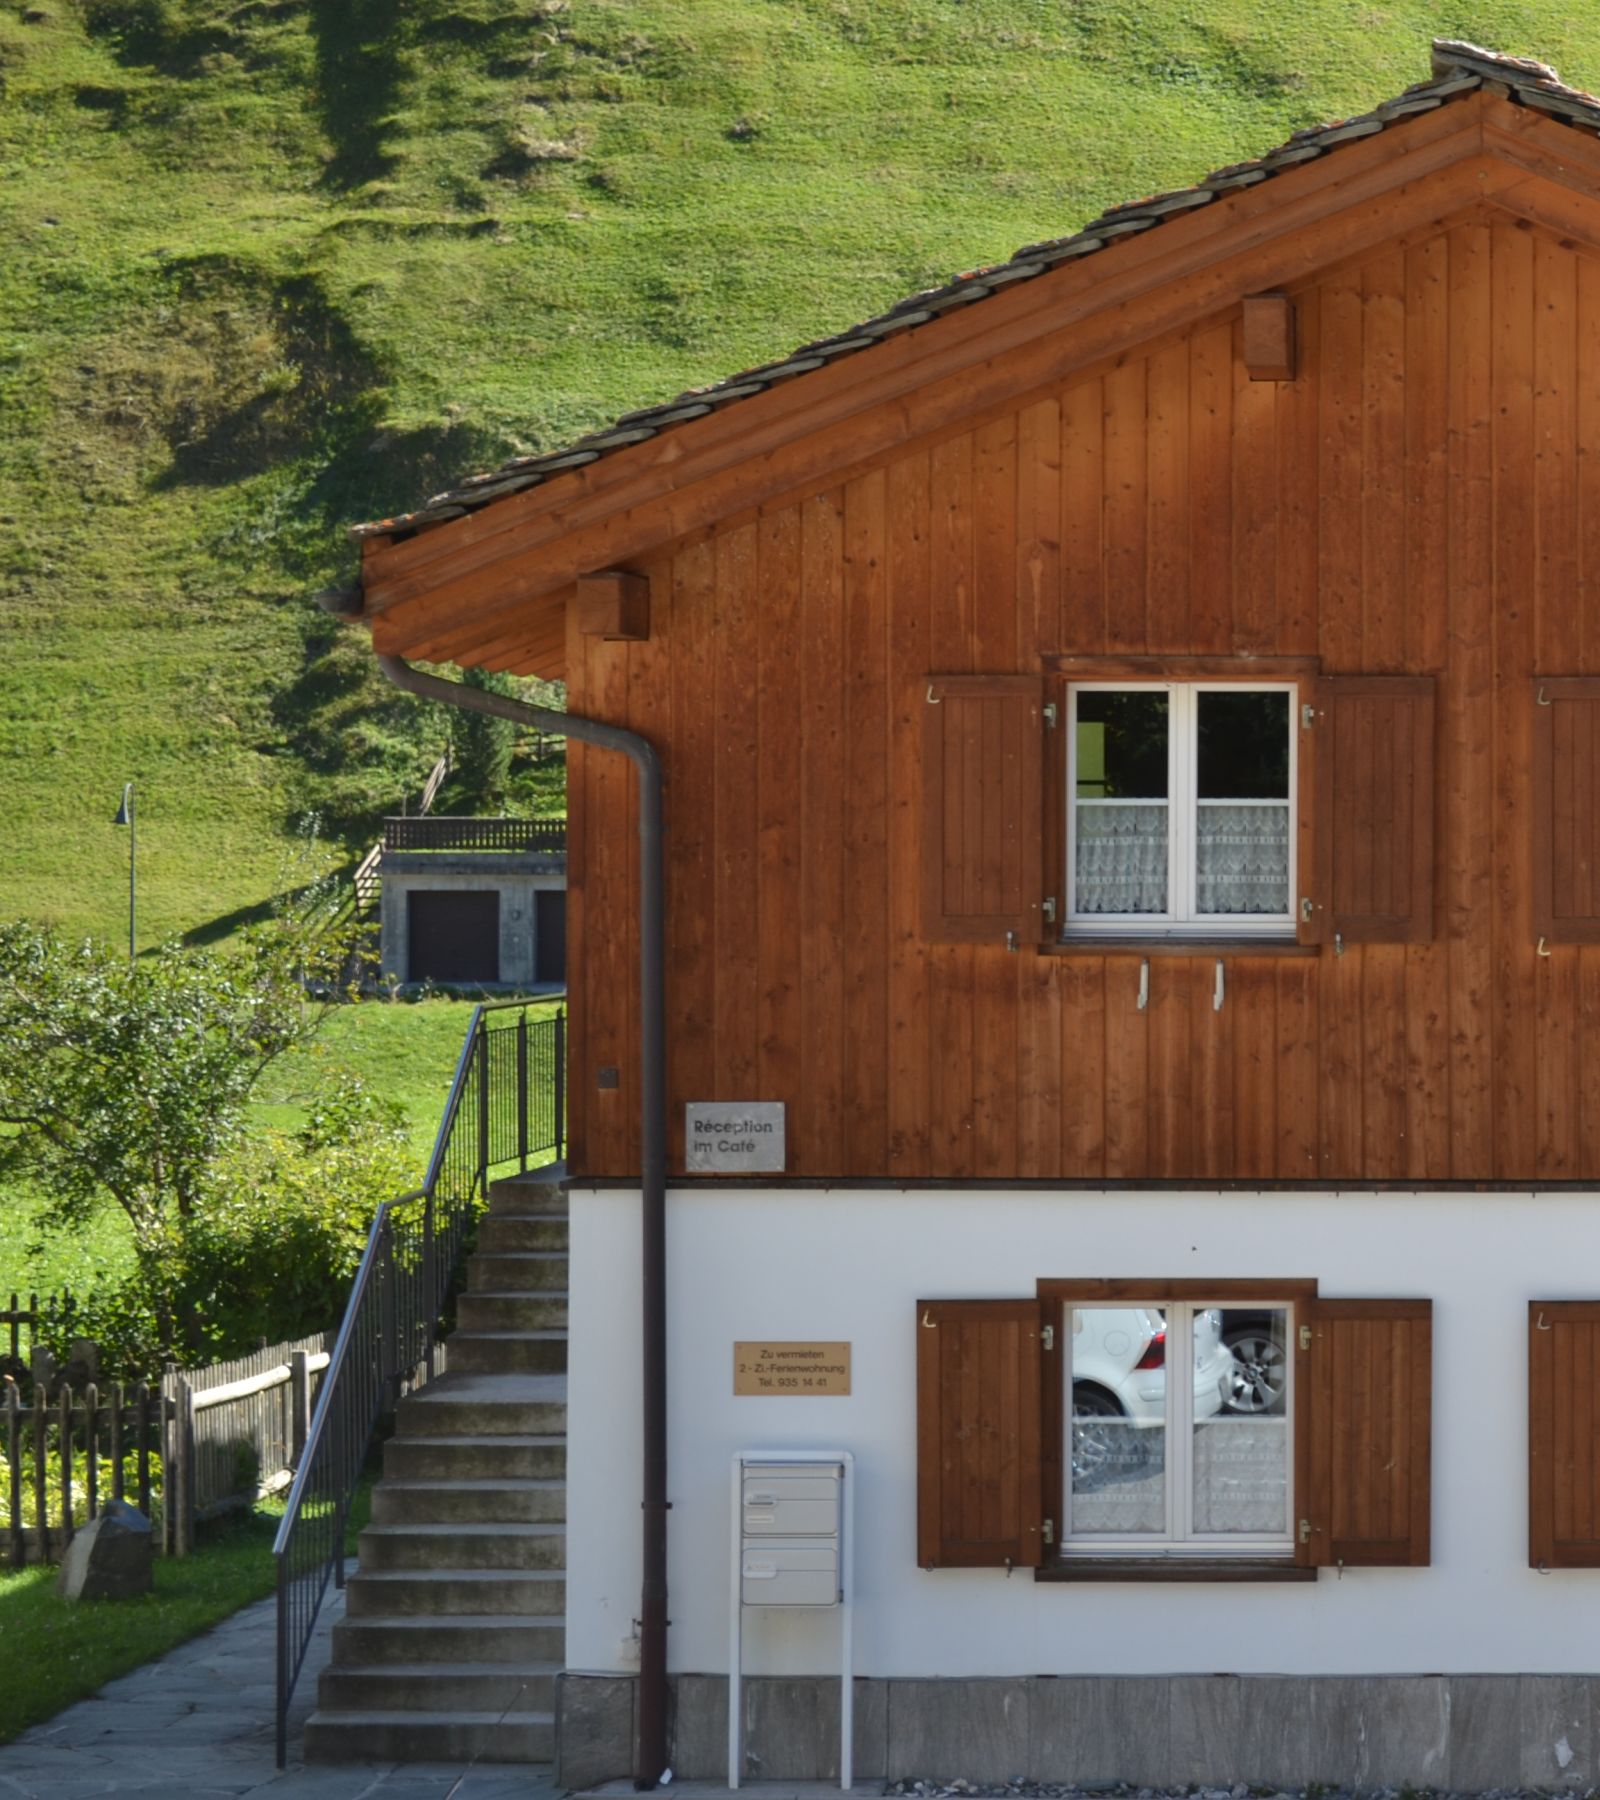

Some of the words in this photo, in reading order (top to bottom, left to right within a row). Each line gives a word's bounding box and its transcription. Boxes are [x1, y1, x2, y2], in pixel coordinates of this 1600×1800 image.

[694, 1140, 712, 1153] im
[717, 1138, 756, 1153] Café
[760, 1349, 774, 1360] Zu
[776, 1349, 825, 1360] vermieten
